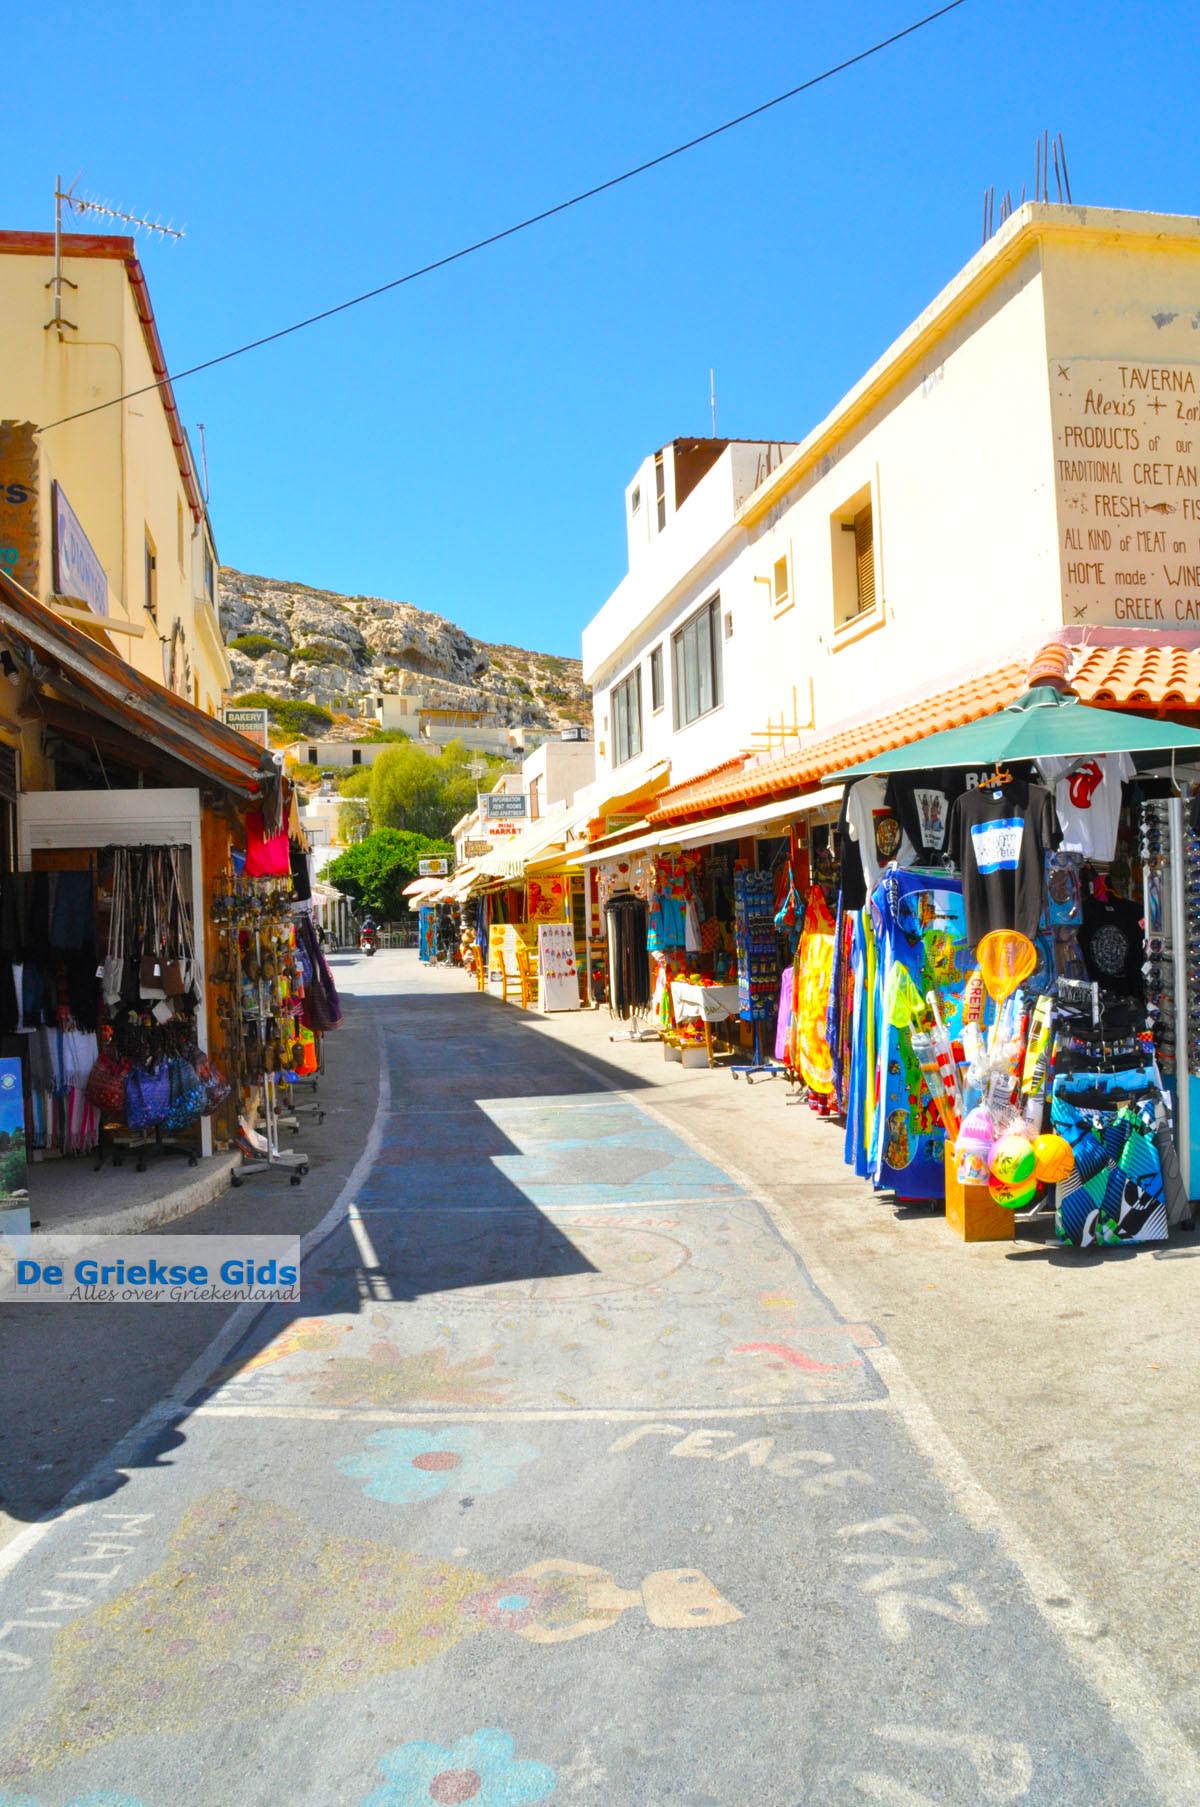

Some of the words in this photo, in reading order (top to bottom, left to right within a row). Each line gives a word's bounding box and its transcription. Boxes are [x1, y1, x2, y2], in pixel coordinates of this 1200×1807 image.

[1118, 366, 1196, 394] TAVERNA
[1084, 388, 1136, 417] Alexis
[1176, 399, 1200, 422] Zor
[1064, 425, 1140, 451] PRODUCTS
[1148, 435, 1161, 452] of
[1175, 439, 1193, 454] our
[1057, 459, 1123, 484] TRADITIONAL
[1132, 462, 1198, 487] CRETAN
[0, 483, 28, 504] S
[1094, 494, 1142, 518] FRESH
[1064, 527, 1084, 550] ALL
[1087, 528, 1112, 551] KIND
[1119, 535, 1132, 552] of
[1136, 530, 1167, 553] MEAT
[1067, 562, 1106, 585] HOME
[1114, 570, 1147, 585] made
[1114, 597, 1165, 620] GREEK
[228, 713, 262, 721] BAKERY
[968, 978, 983, 1020] CRETE
